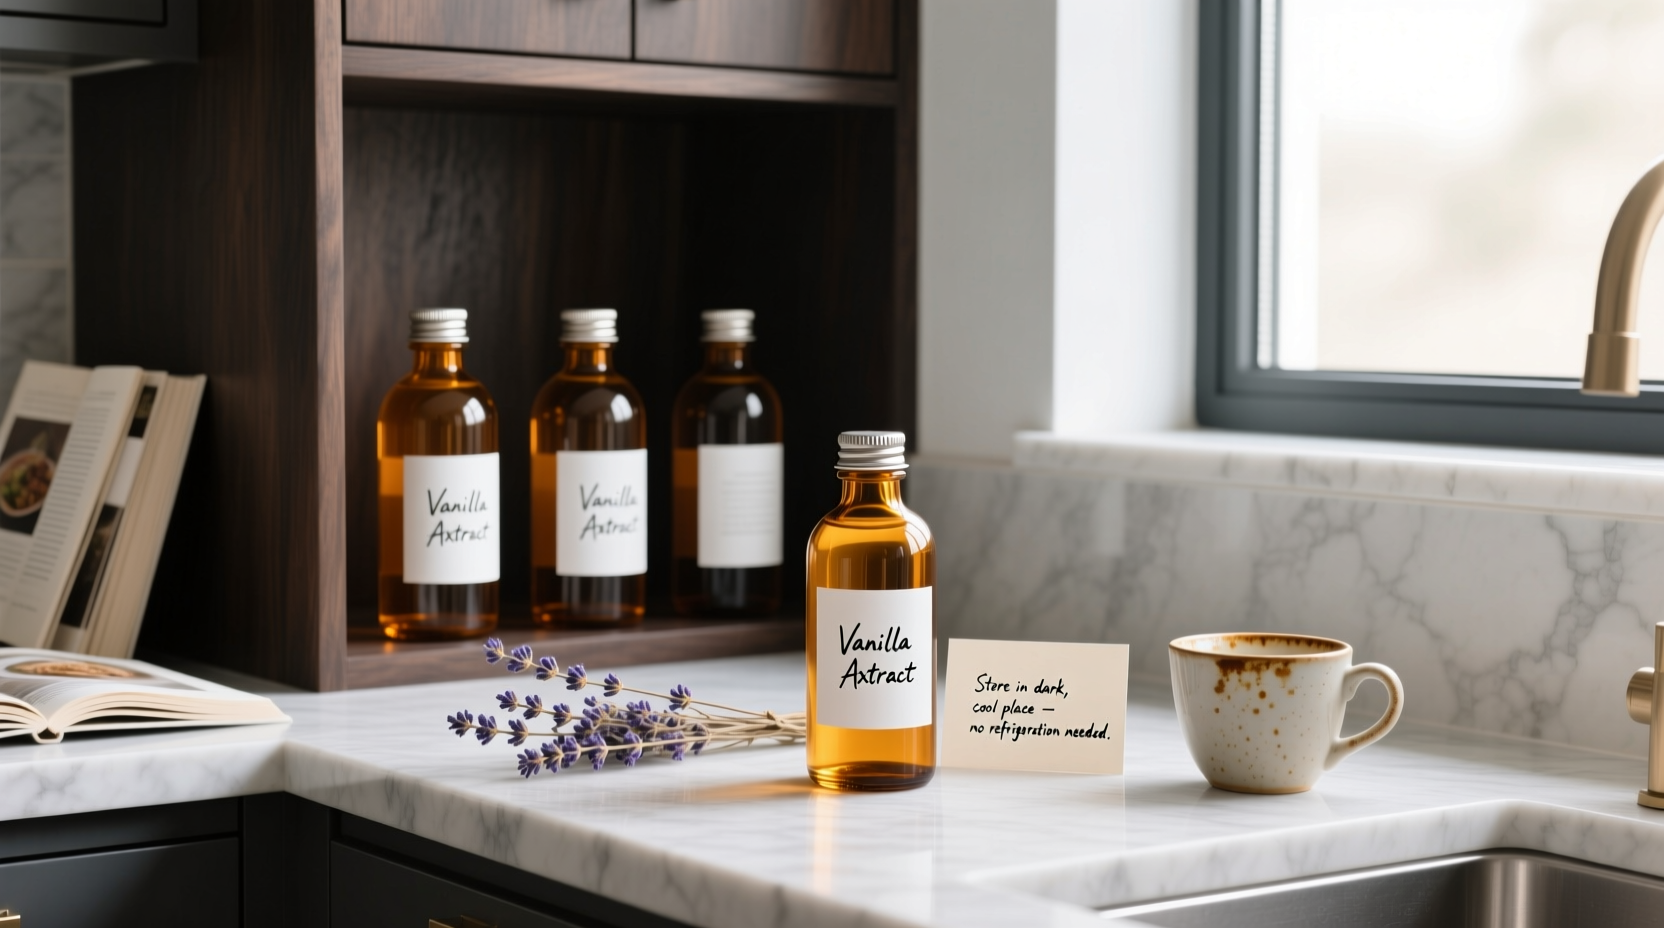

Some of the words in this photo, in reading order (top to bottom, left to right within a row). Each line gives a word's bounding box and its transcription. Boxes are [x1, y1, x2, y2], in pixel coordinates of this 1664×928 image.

[427, 488, 488, 516] Vanilla
[579, 482, 638, 511] Vanilla
[426, 519, 490, 548] Axtract
[839, 622, 912, 656] Vanilla
[839, 657, 917, 690] Axtract
[1015, 681, 1028, 692] in
[1033, 678, 1069, 699] dark,
[972, 699, 999, 713] cool
[1000, 698, 1035, 721] place
[969, 725, 985, 734] no
[1064, 722, 1111, 740] needed.
